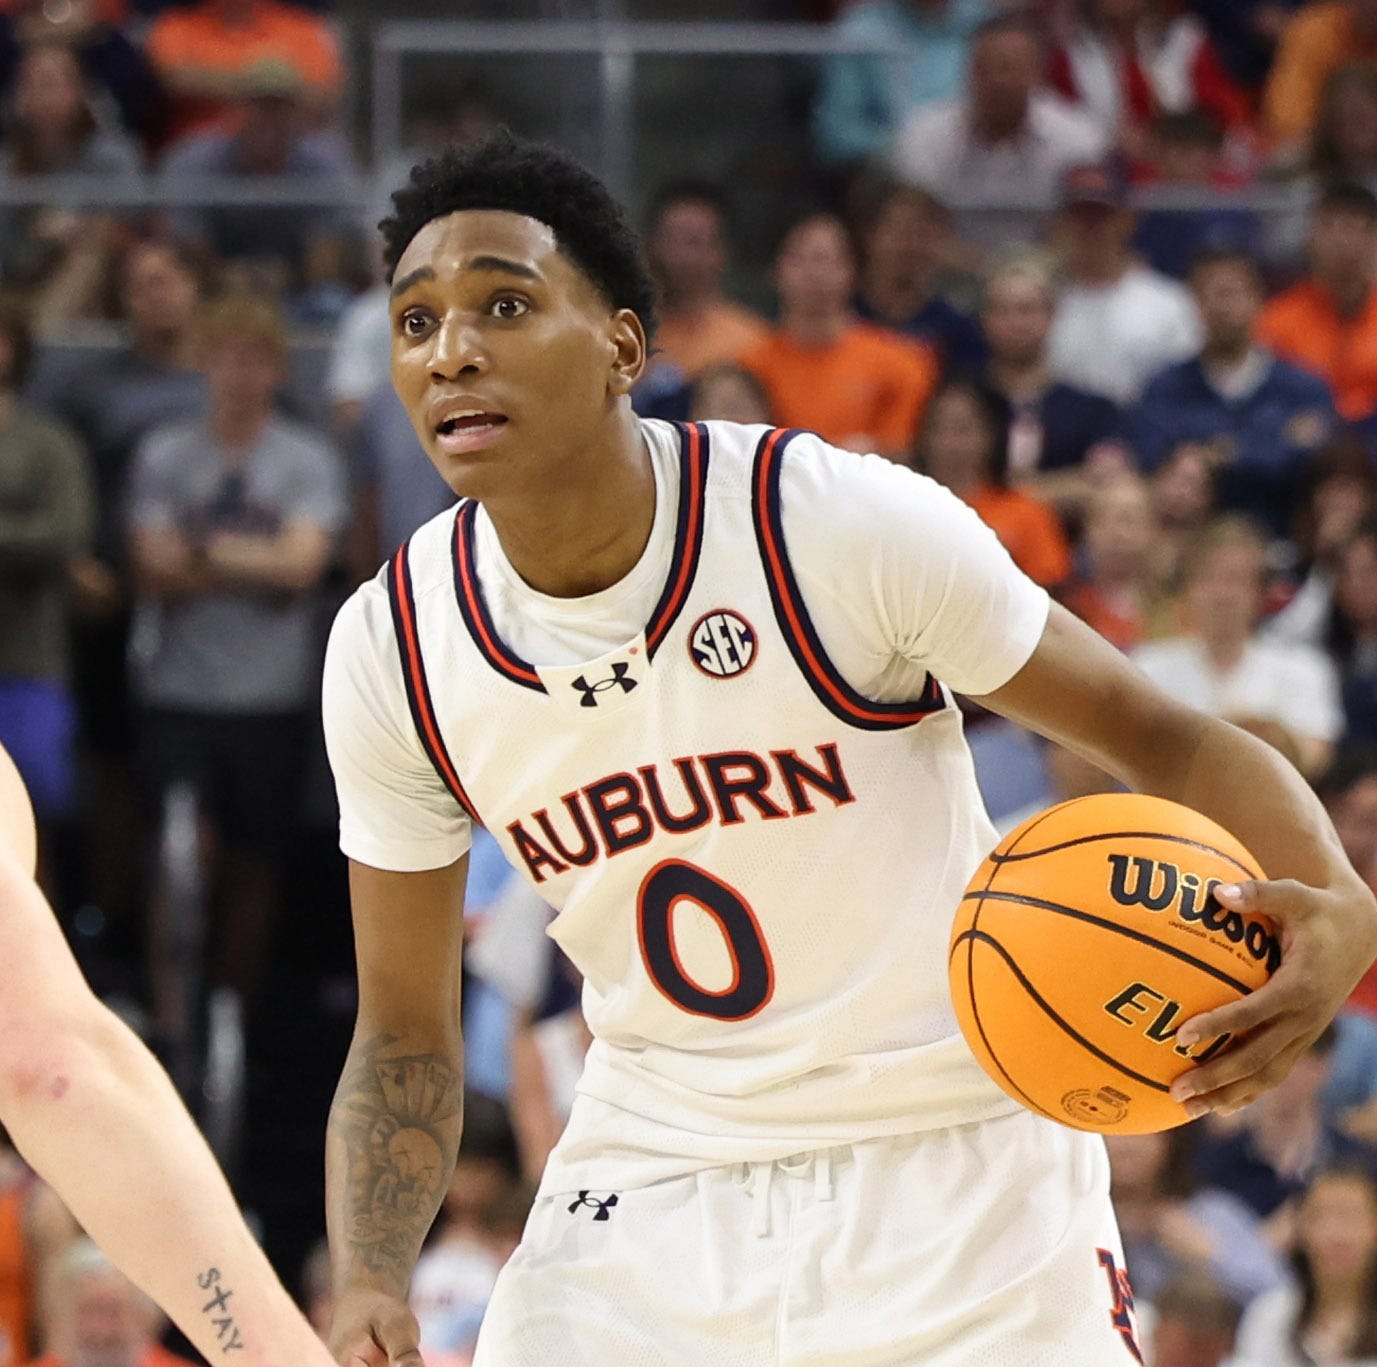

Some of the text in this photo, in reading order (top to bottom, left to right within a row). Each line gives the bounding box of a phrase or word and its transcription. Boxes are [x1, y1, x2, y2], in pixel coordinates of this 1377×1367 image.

[691, 612, 754, 676] SEC
[506, 742, 856, 884] AUBURN
[635, 857, 775, 1022] 0
